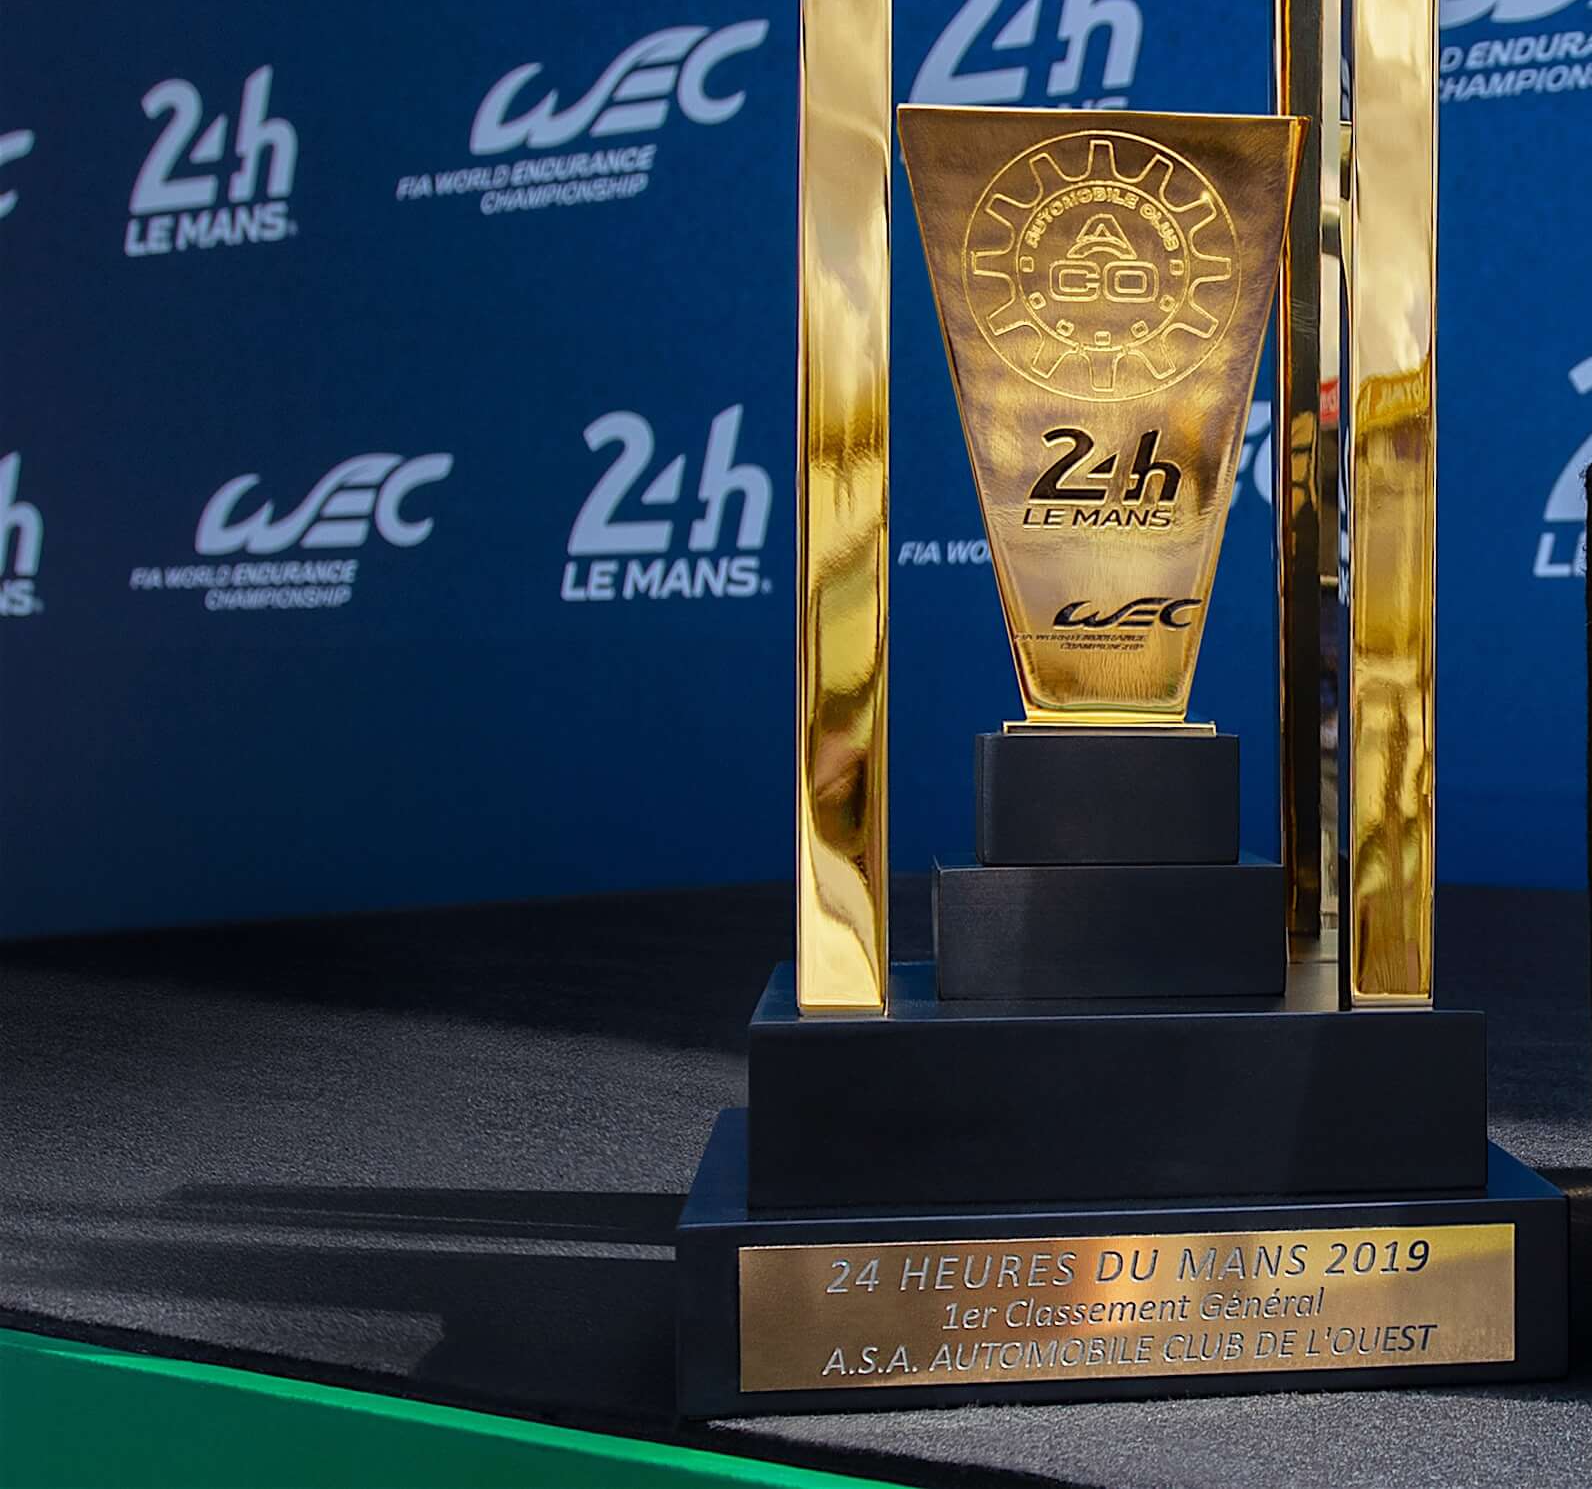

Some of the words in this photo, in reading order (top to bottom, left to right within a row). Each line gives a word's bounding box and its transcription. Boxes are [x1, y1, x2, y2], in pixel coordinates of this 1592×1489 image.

[470, 19, 770, 156] WEC
[129, 64, 298, 216] 24h
[395, 173, 433, 202] FIA
[433, 163, 511, 197] WORLD
[509, 143, 657, 187] ENDURANCE
[479, 172, 650, 216] CHAMPIONSHIP
[124, 213, 175, 258] LE
[567, 403, 774, 556] 24h
[1028, 425, 1182, 506] 24h
[196, 453, 454, 555] WEC
[1023, 507, 1065, 529] LE
[1071, 507, 1173, 530] MANS
[898, 540, 942, 566] FIA
[561, 559, 619, 602] LE
[1053, 597, 1202, 631] WEC
[825, 1257, 881, 1294] 24
[899, 1251, 1077, 1292] HEURES
[1094, 1249, 1159, 1285] DU
[1176, 1243, 1309, 1281] MANS
[1324, 1239, 1431, 1277] 2019
[942, 1301, 997, 1331] 1er
[1005, 1295, 1191, 1329] Classement
[1199, 1287, 1326, 1321] Général
[822, 1345, 919, 1377] A.S.A.
[928, 1335, 1154, 1373] AUTOMOBILE
[1162, 1331, 1244, 1362] CLUB
[1254, 1329, 1298, 1358] DE
[1304, 1324, 1439, 1357] L'OUEST
